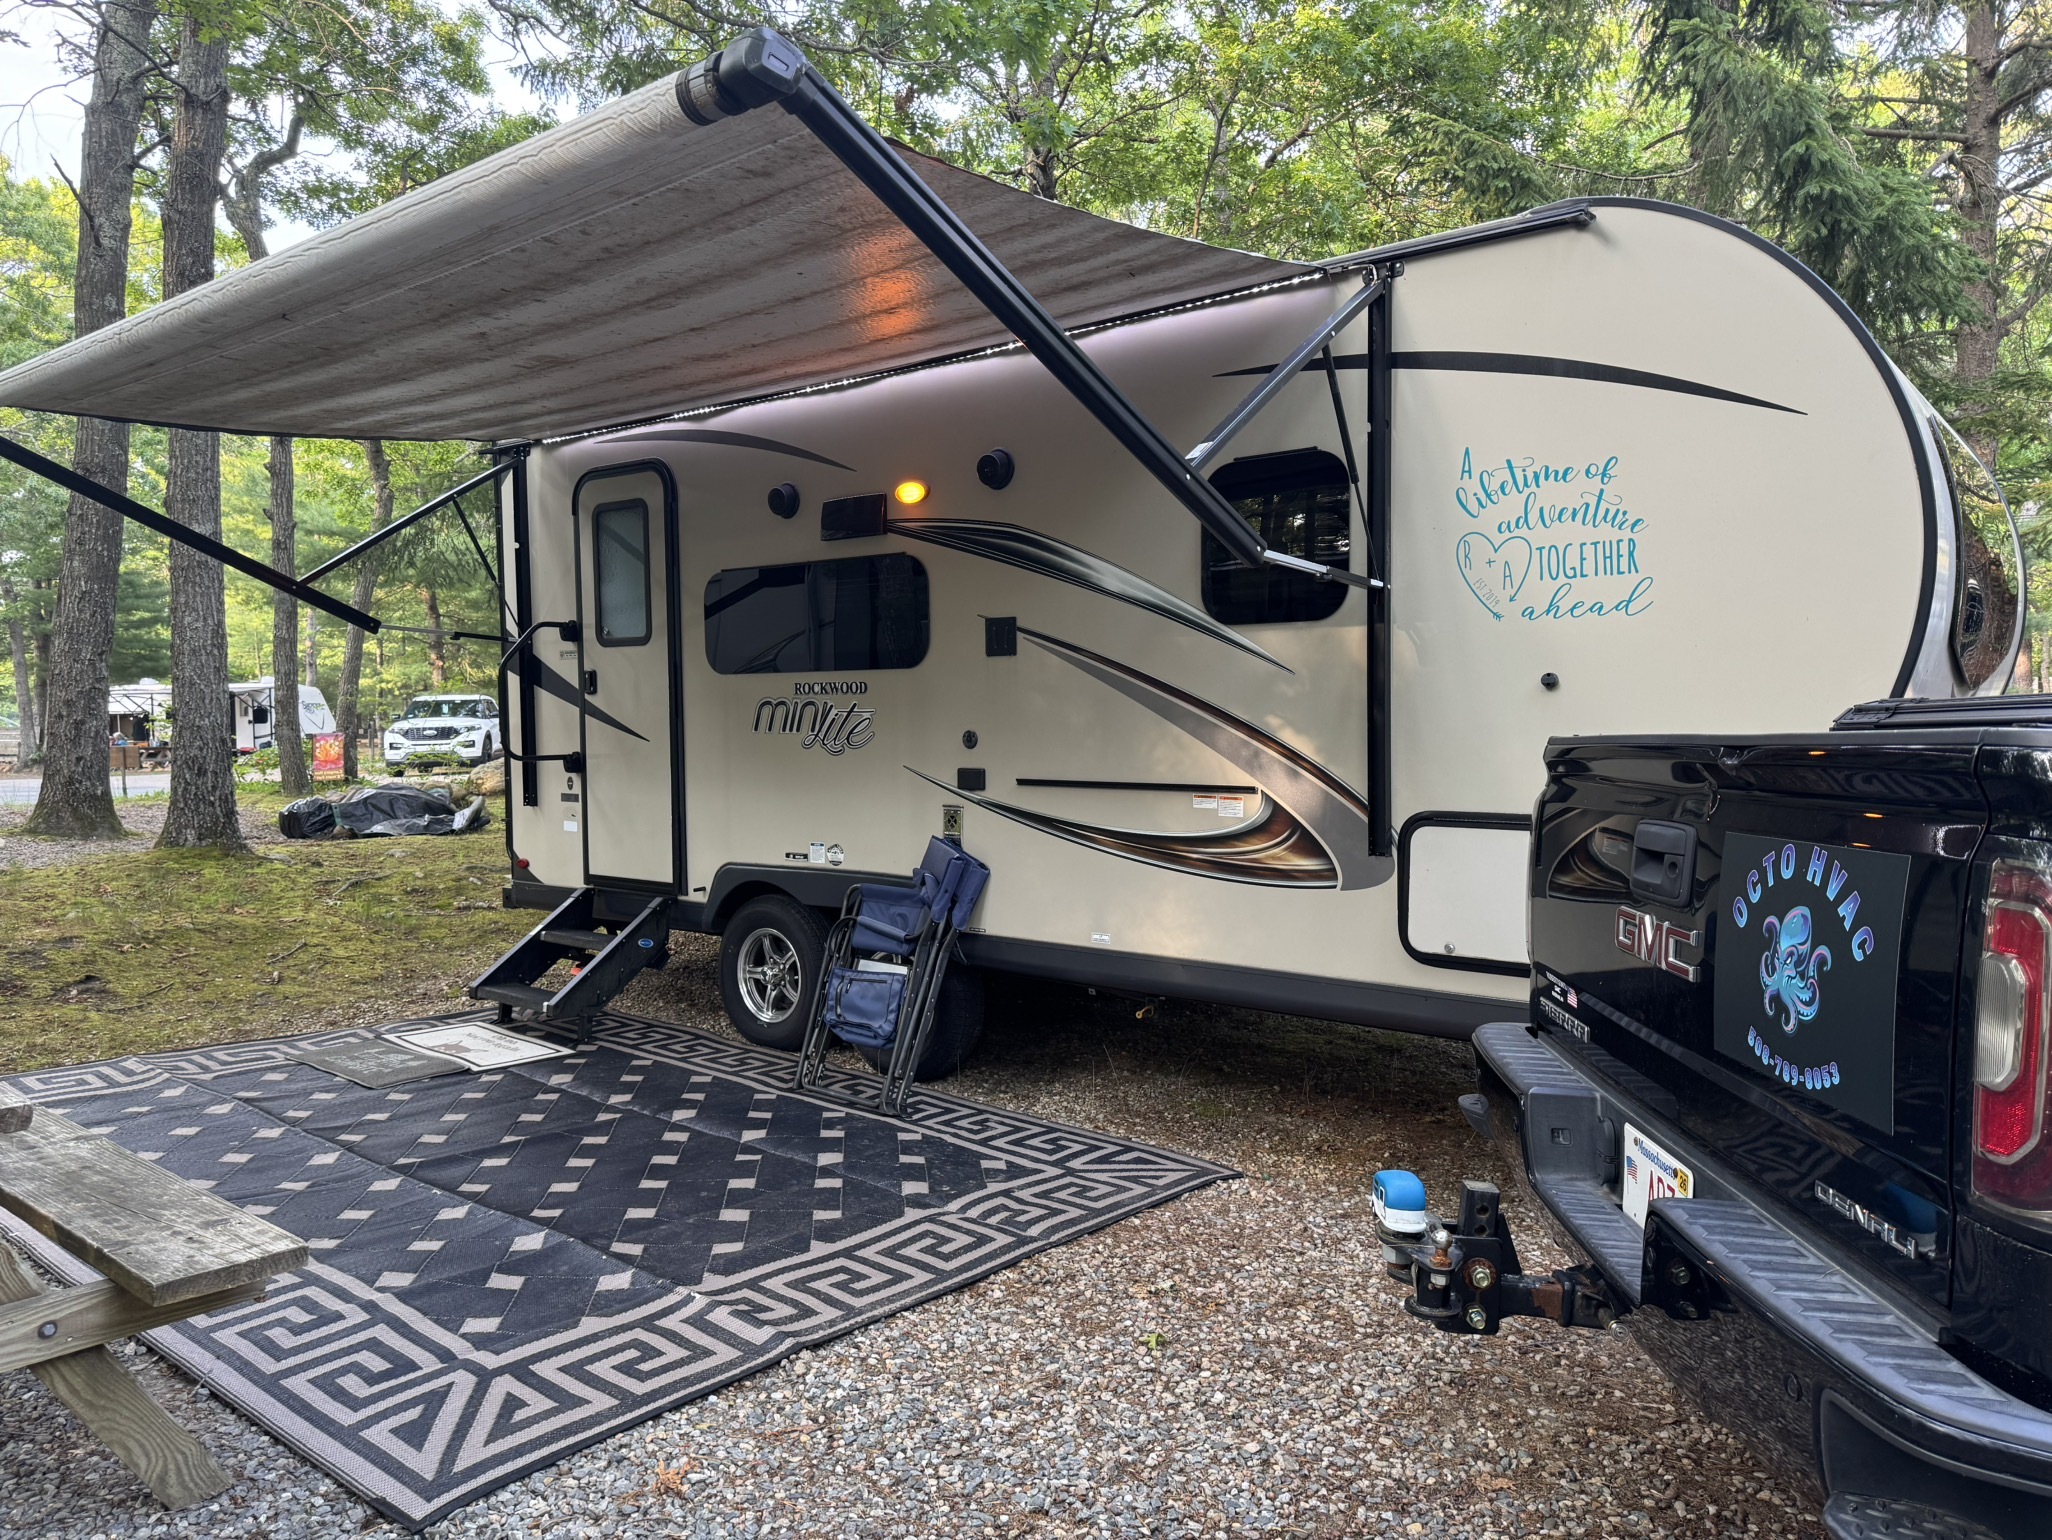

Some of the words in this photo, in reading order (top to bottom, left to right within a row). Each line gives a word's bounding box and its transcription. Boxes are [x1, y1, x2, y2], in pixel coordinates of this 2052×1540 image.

[1455, 457, 1581, 519] lifetime
[1584, 456, 1619, 485] of
[1460, 446, 1472, 481] A
[1497, 488, 1649, 534] adventure
[1463, 539, 1472, 571] R
[1502, 560, 1514, 590] A
[1535, 537, 1639, 582] TOGETHER
[1520, 576, 1653, 621] ahead
[794, 681, 868, 695] ROCKWOOD
[1733, 843, 1796, 928] OCTO
[1806, 845, 1874, 962] HVAC
[1615, 905, 1701, 983] GMC
[1747, 1025, 1840, 1090] 508-789-8053
